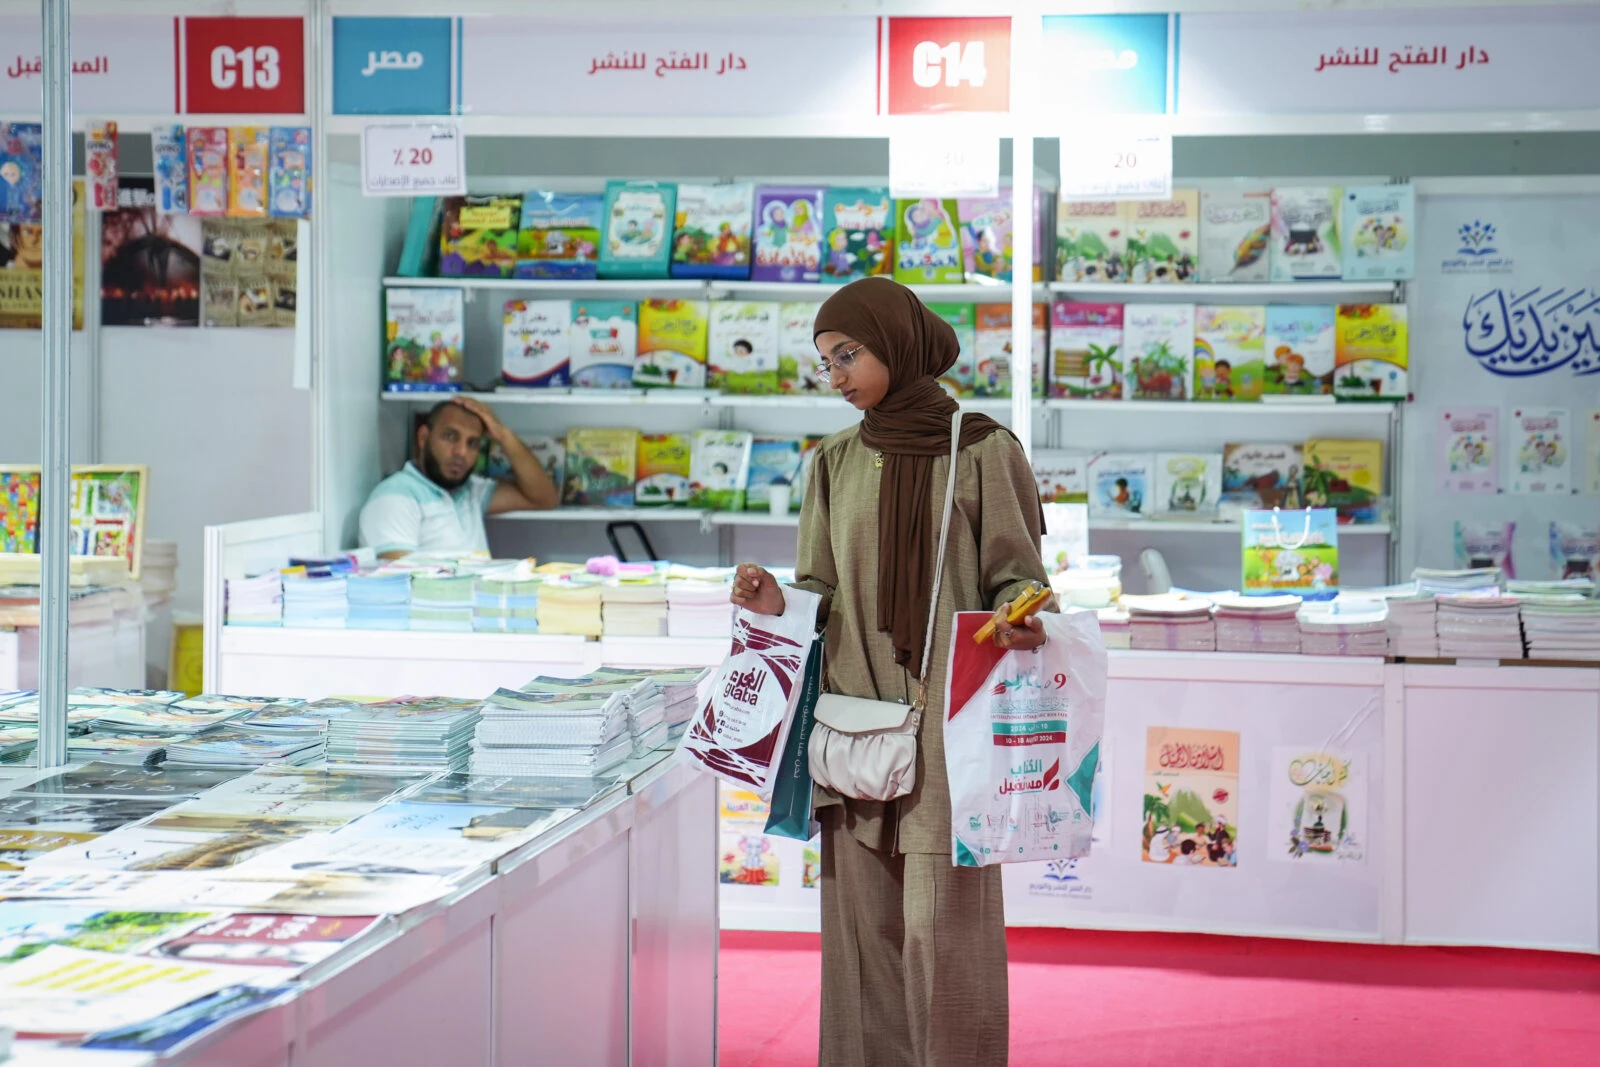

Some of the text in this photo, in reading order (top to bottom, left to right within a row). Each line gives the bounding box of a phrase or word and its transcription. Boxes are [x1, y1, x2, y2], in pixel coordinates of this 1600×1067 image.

[8, 58, 108, 78] المقبل
[210, 46, 280, 89] C13
[361, 51, 423, 76] مصر
[588, 54, 748, 77] دار الفتح للنشر
[912, 41, 987, 88] C14
[1316, 46, 1490, 73] دار الفتح للنشر
[408, 147, 434, 165] 20
[1111, 152, 1137, 169] 20
[1053, 673, 1067, 690] 9
[1011, 759, 1043, 778] الكتاب
